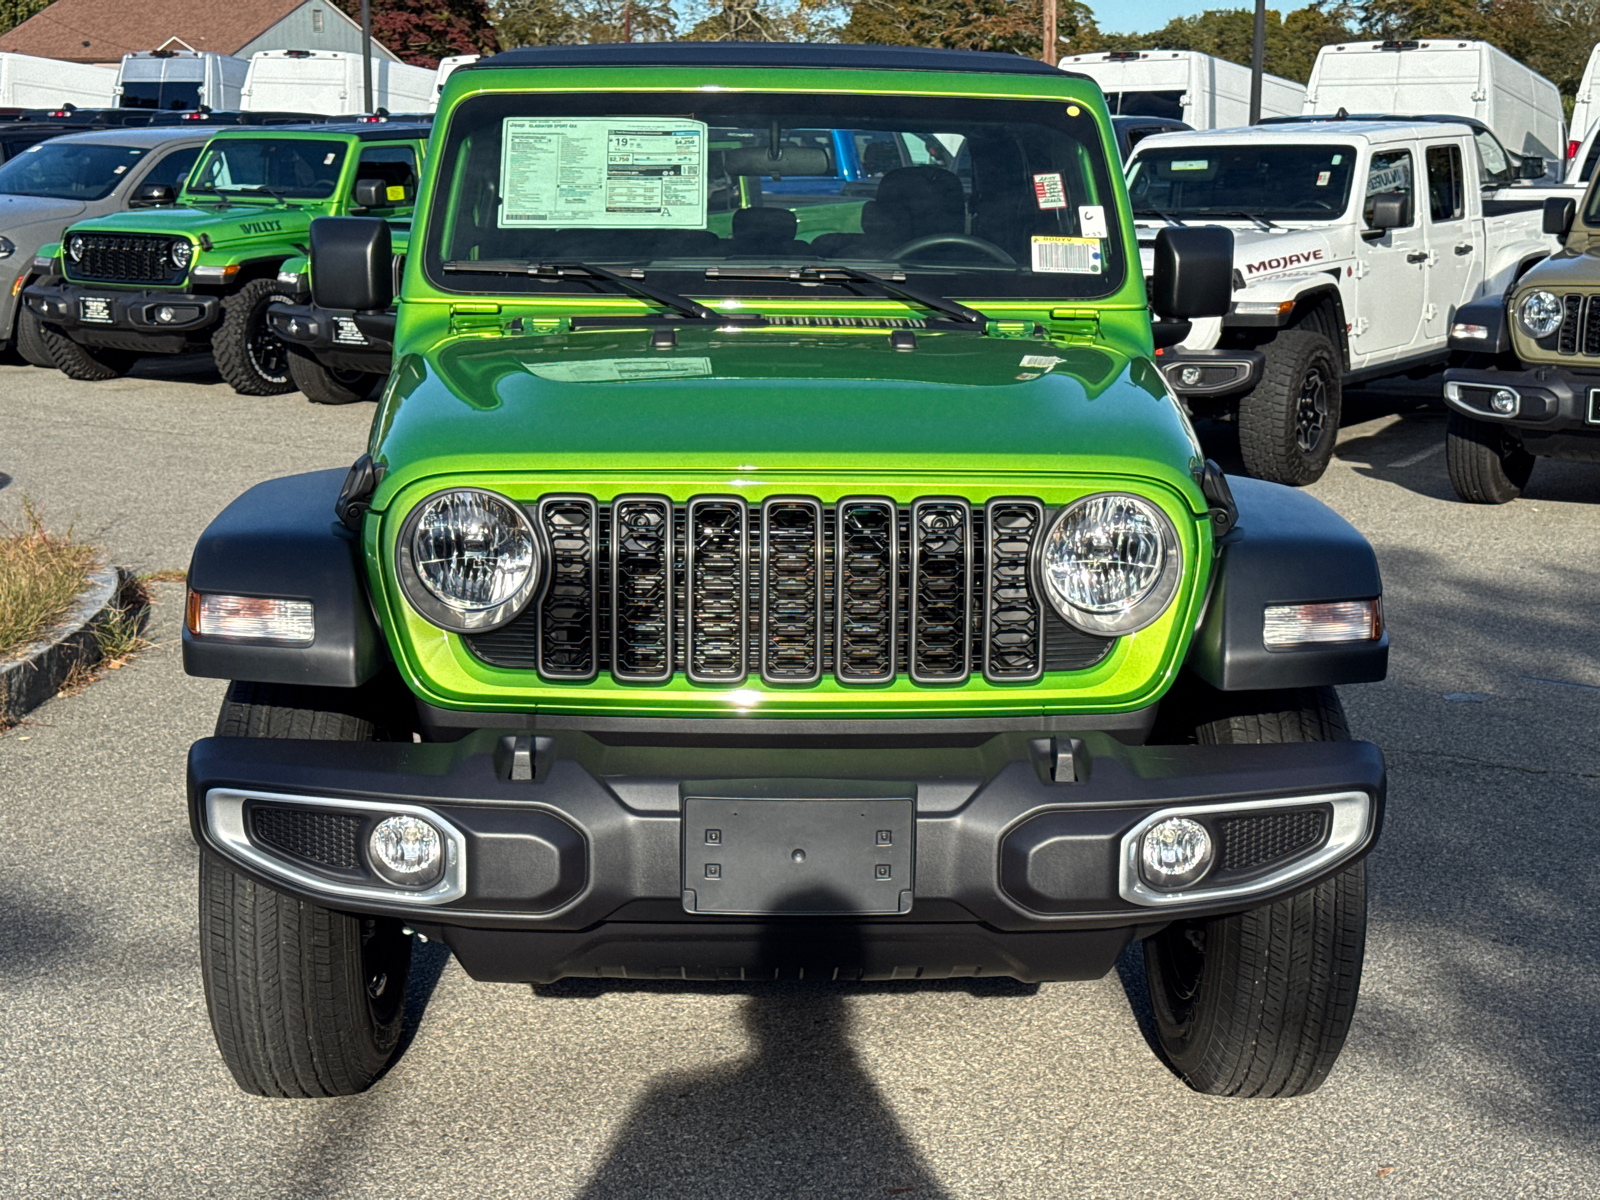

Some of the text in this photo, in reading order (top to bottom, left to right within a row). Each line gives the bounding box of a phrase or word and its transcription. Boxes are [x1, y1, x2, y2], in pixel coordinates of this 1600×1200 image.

[615, 138, 628, 146] 19
[239, 219, 282, 235] WILLYS
[1245, 248, 1324, 275] MOJAVE
